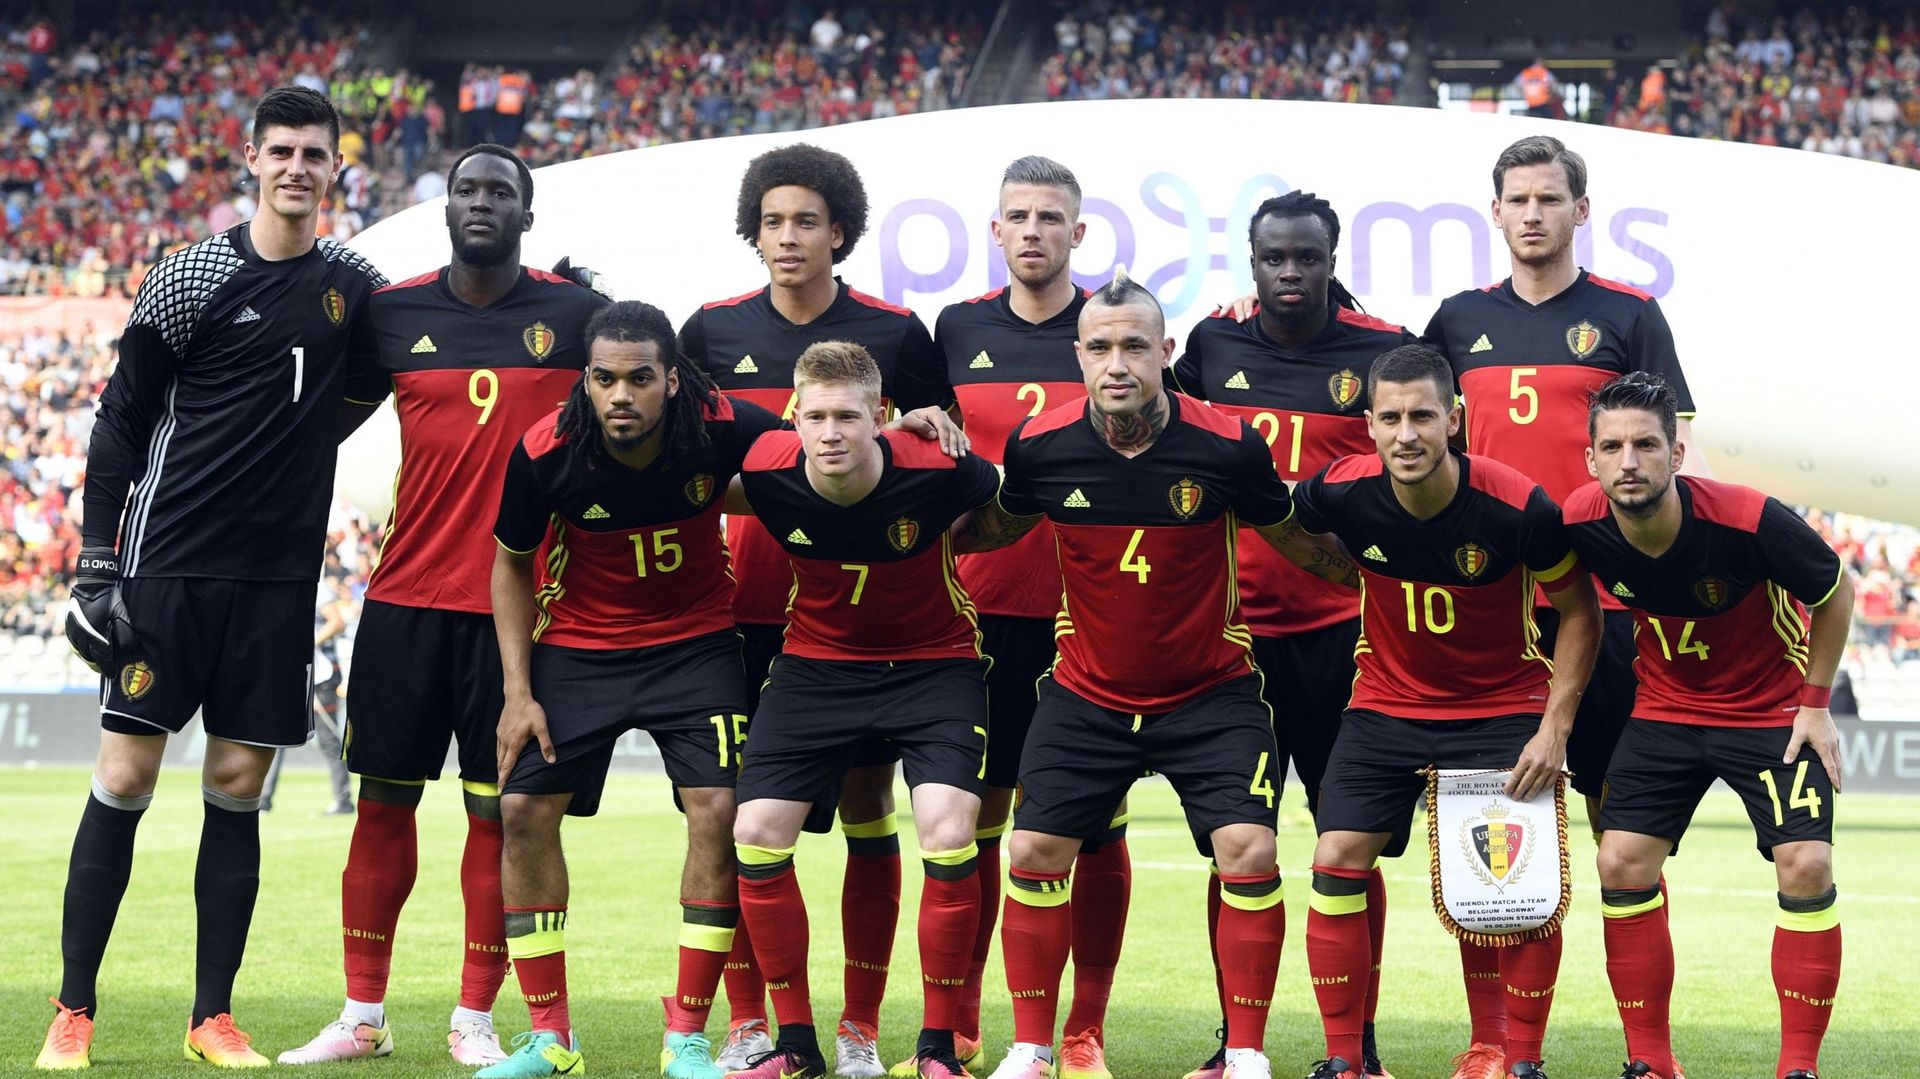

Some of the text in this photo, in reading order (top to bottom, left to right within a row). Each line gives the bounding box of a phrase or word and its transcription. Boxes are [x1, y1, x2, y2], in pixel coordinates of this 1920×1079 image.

[880, 172, 1675, 320] poxms
[233, 313, 261, 323] adidas
[292, 347, 303, 402] 1
[468, 368, 499, 425] 9
[1016, 382, 1047, 419] 2
[1508, 367, 1539, 425] 5
[1251, 411, 1305, 473] 21
[81, 559, 118, 571] TCMD 13
[629, 528, 683, 578] 15
[1119, 529, 1152, 584] 4
[841, 564, 869, 605] 7
[1400, 581, 1455, 634] 10
[1647, 616, 1710, 661] 14
[709, 714, 748, 768] 15
[973, 725, 987, 780] 7
[1249, 751, 1275, 809] 4
[1758, 760, 1822, 827] 14
[343, 927, 385, 942] ELGIUM
[525, 990, 558, 1002] LGIUM
[683, 995, 713, 1006] BELG
[1312, 975, 1349, 985] GIUM
